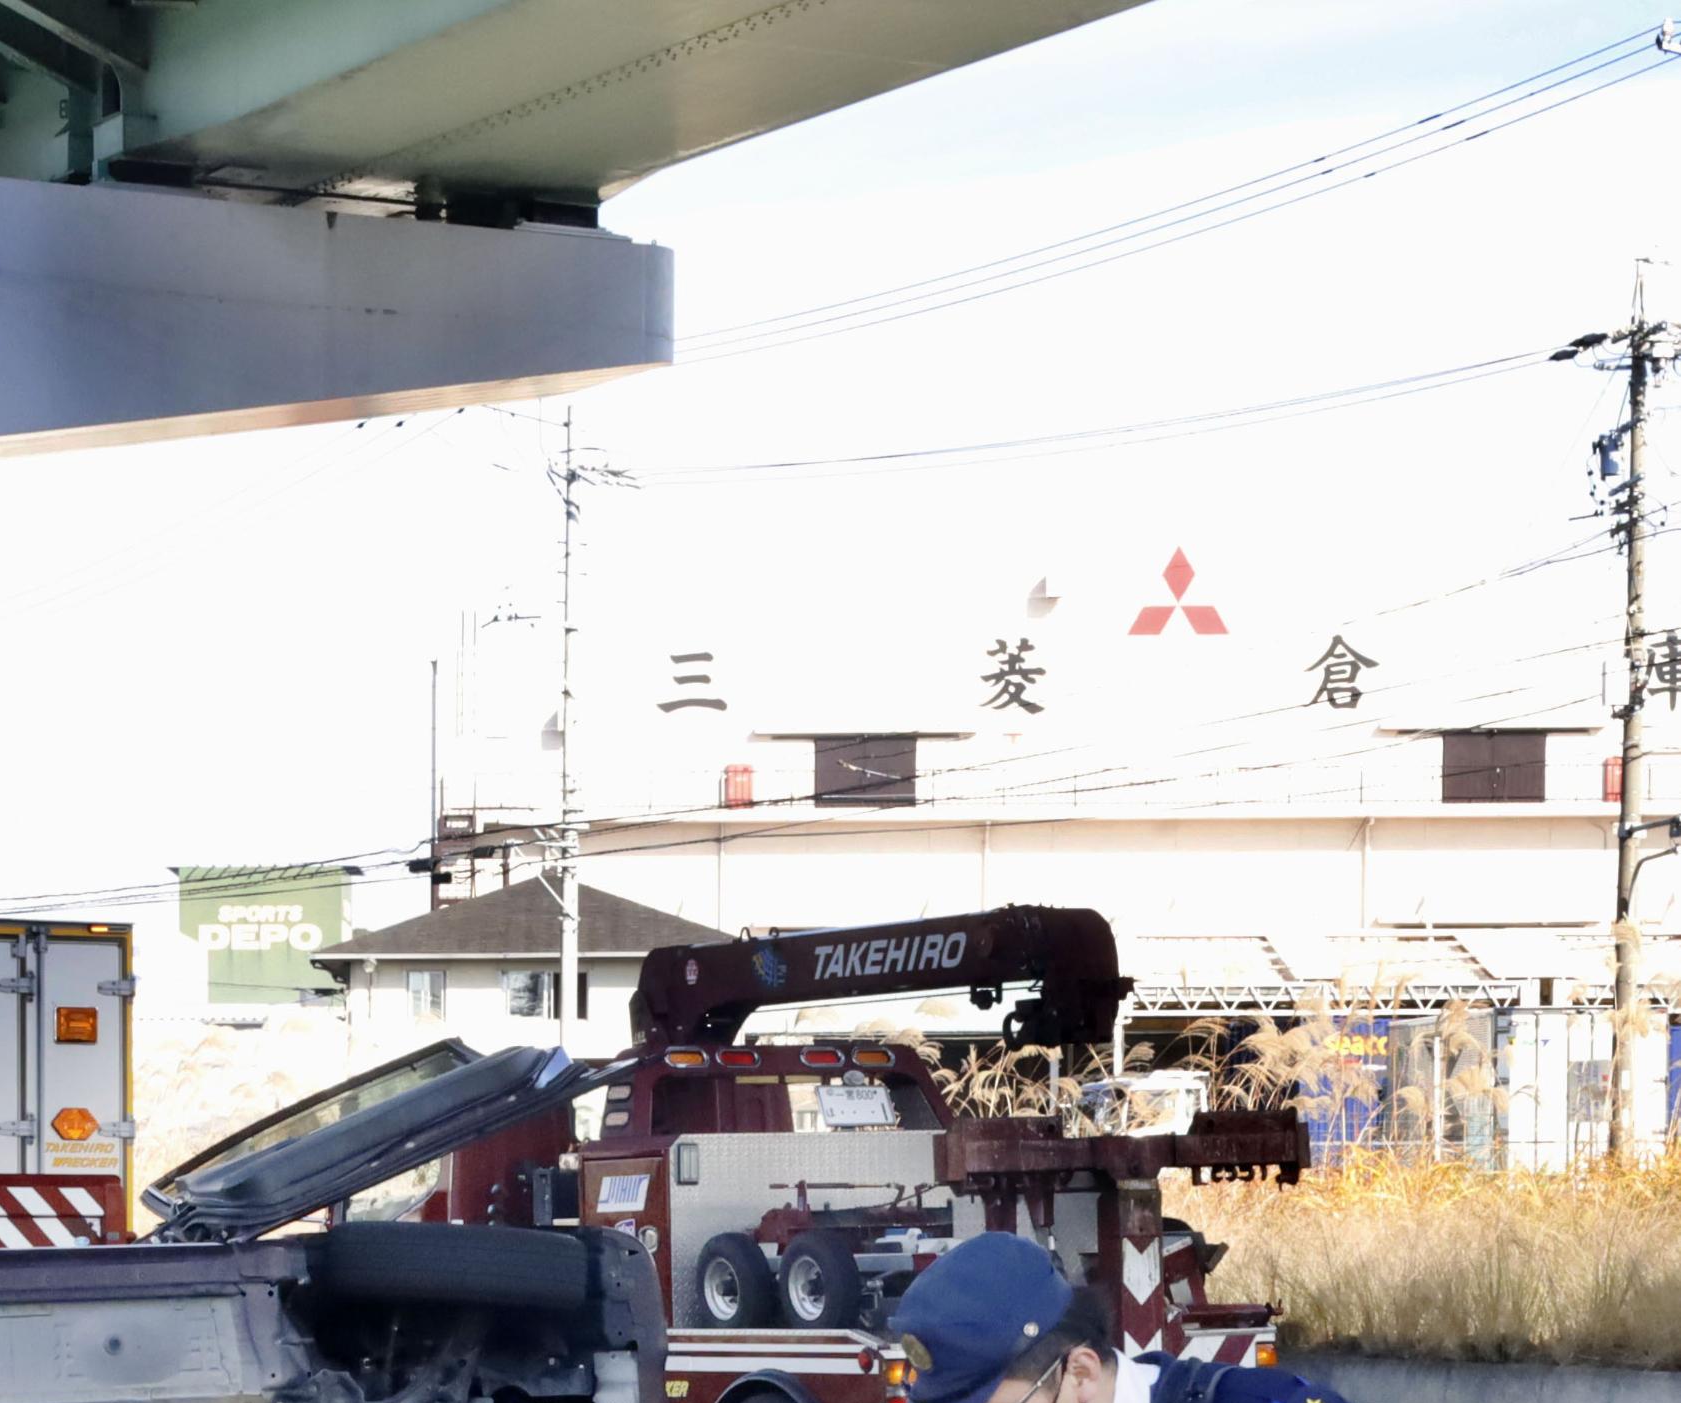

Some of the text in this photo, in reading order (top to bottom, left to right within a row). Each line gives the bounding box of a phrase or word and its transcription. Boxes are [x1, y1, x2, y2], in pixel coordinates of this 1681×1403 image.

[217, 905, 303, 922] SPORTS
[198, 923, 323, 951] DEPO
[814, 932, 967, 980] TAKEHIRO
[45, 1142, 115, 1153] TAKEHIRO
